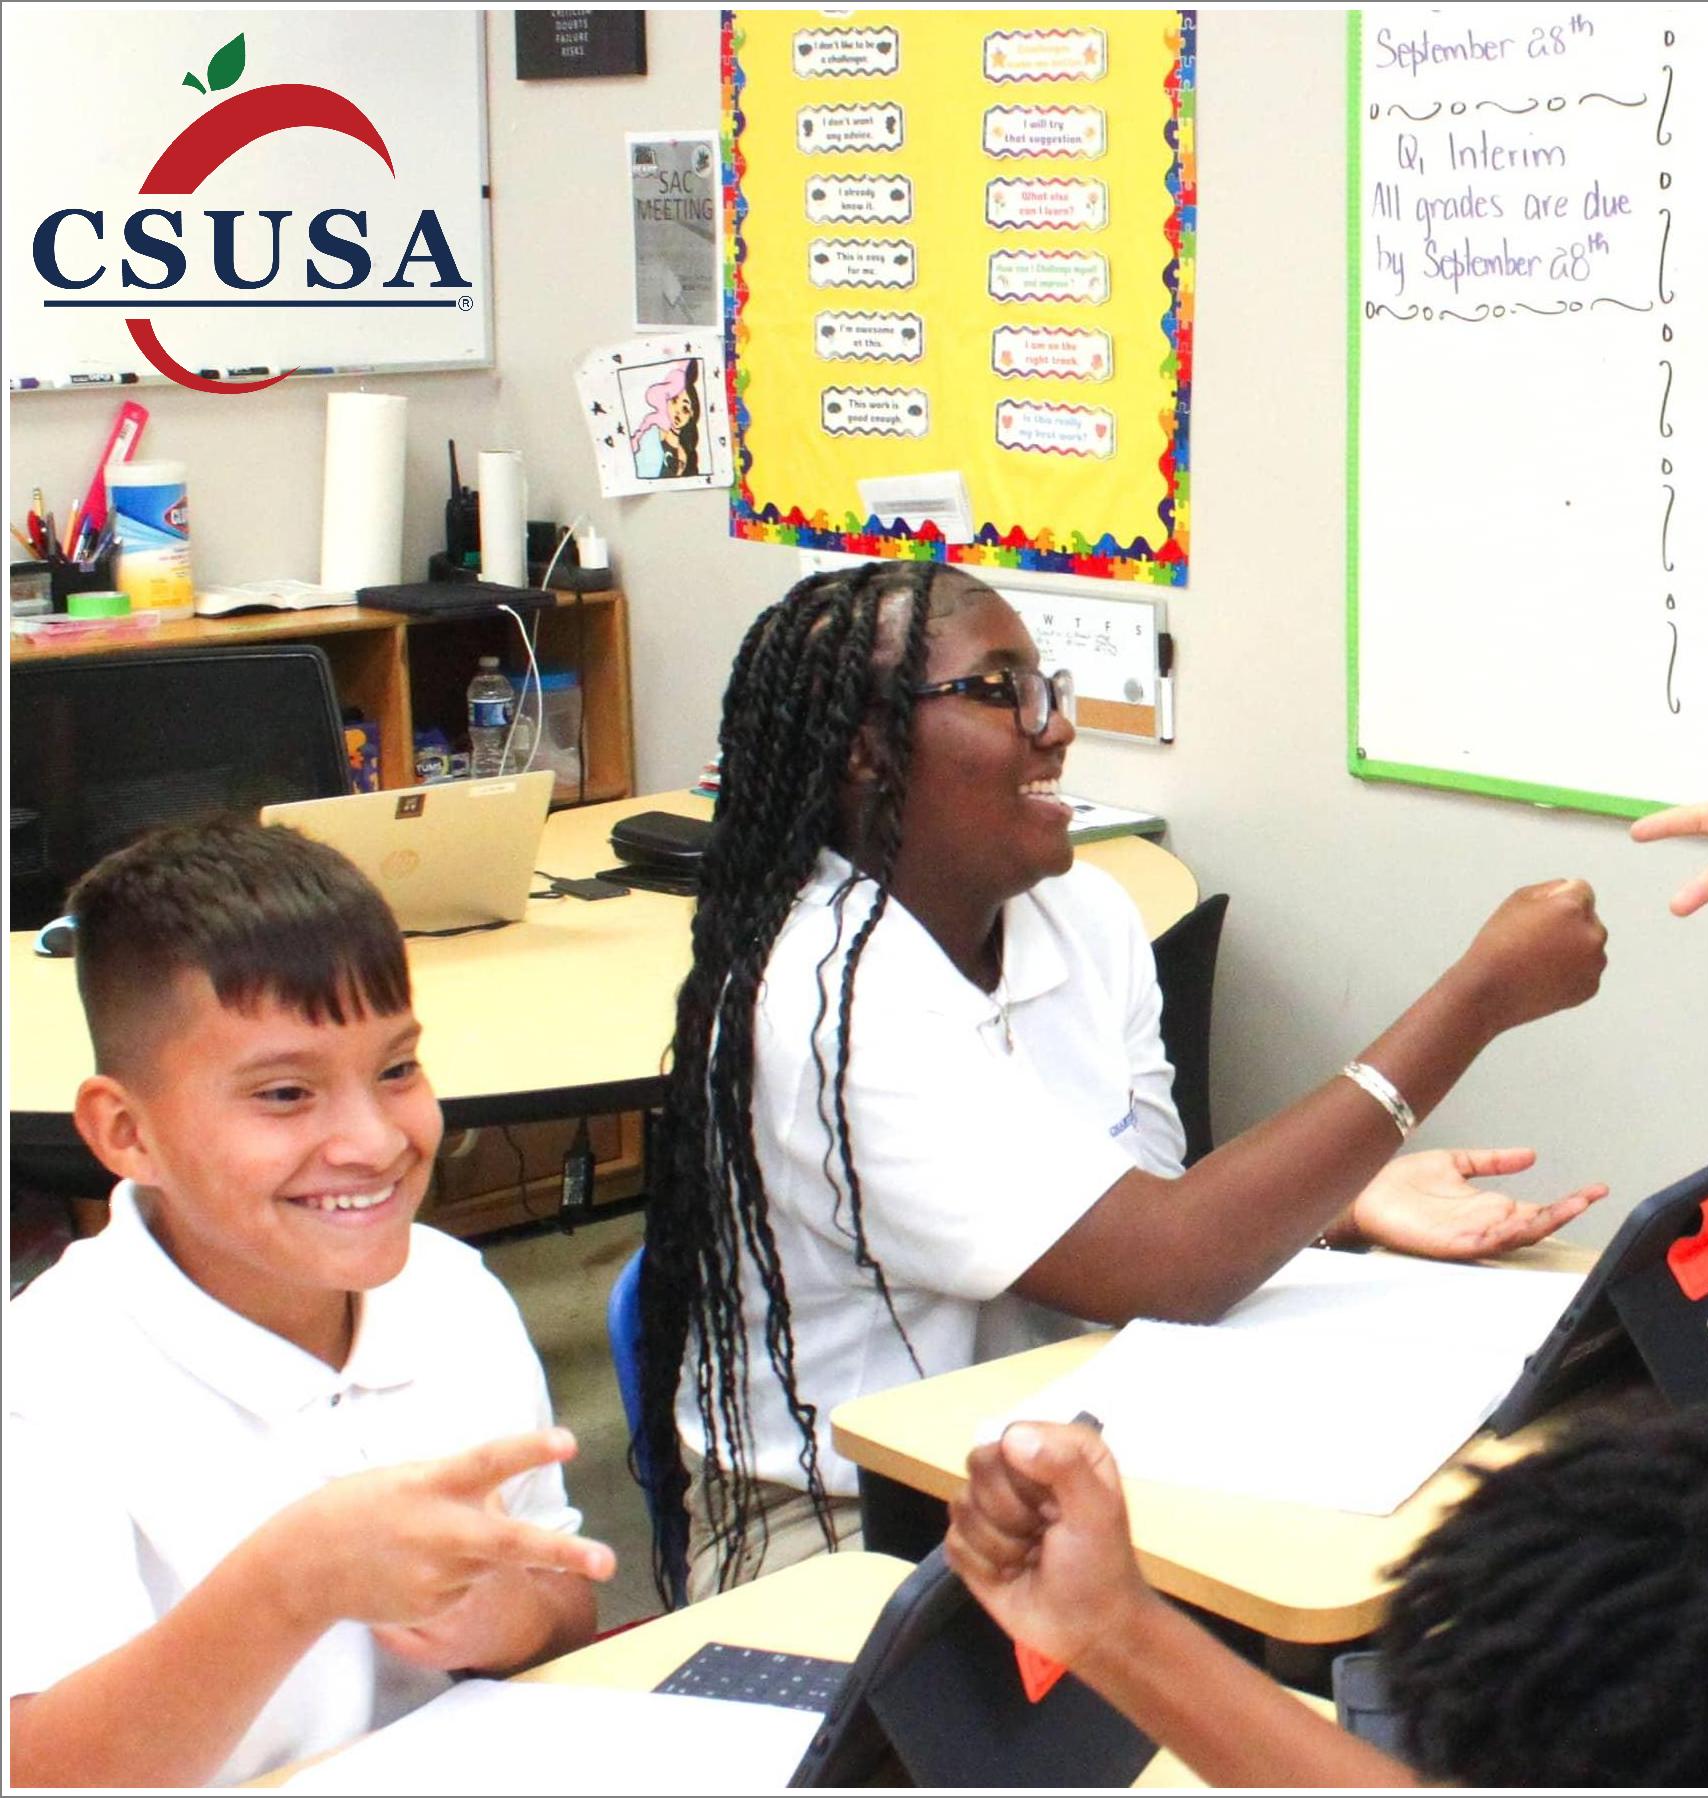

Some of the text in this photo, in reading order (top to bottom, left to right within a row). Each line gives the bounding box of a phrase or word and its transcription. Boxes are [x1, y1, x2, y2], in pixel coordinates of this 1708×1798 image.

[1376, 28, 1515, 77] September
[1050, 120, 1064, 131] try
[1005, 133, 1026, 143] that
[1449, 129, 1566, 171] Interim
[659, 170, 694, 195] SAC
[636, 198, 714, 221] MEETING
[1371, 179, 1632, 241] All grades are due
[1377, 235, 1406, 297] by
[1424, 237, 1542, 295] September
[849, 399, 866, 409] This
[869, 400, 888, 410] work
[1043, 613, 1142, 636] W T F S
